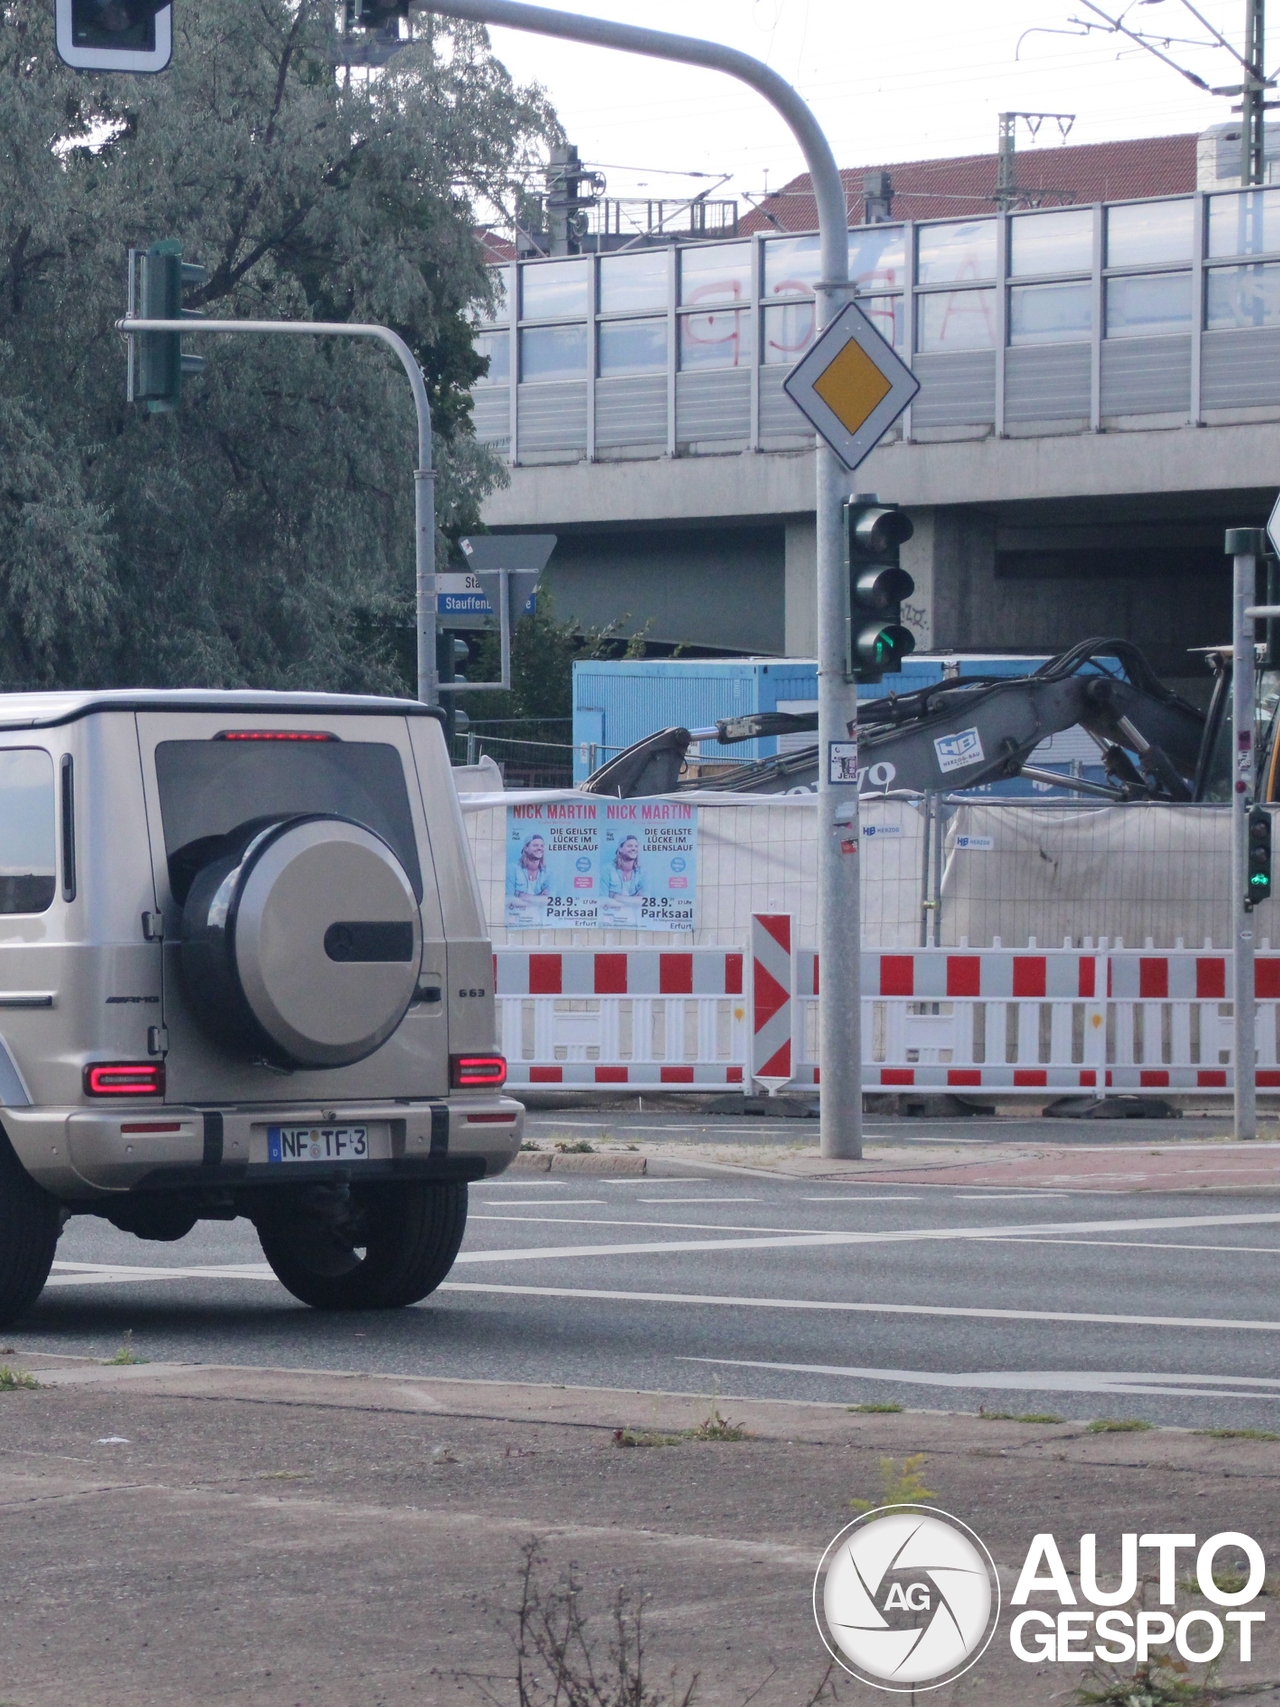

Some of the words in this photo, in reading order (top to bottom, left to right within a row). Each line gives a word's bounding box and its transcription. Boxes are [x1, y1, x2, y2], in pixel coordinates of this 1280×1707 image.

[465, 577, 481, 588] Sta
[513, 804, 542, 819] NICK
[547, 804, 597, 819] MARTIN
[607, 804, 637, 819] NICK
[641, 804, 691, 819] MARTIN
[862, 826, 876, 836] HB
[553, 834, 578, 843] LÜCKE
[647, 834, 673, 843] LÜCKE
[547, 897, 577, 906] 28.9.
[641, 897, 672, 907] 28.9.
[546, 907, 598, 917] Parksaal
[641, 908, 693, 918] Parksaal
[469, 989, 485, 997] 63
[282, 1131, 308, 1157] NF
[272, 1148, 278, 1157] D
